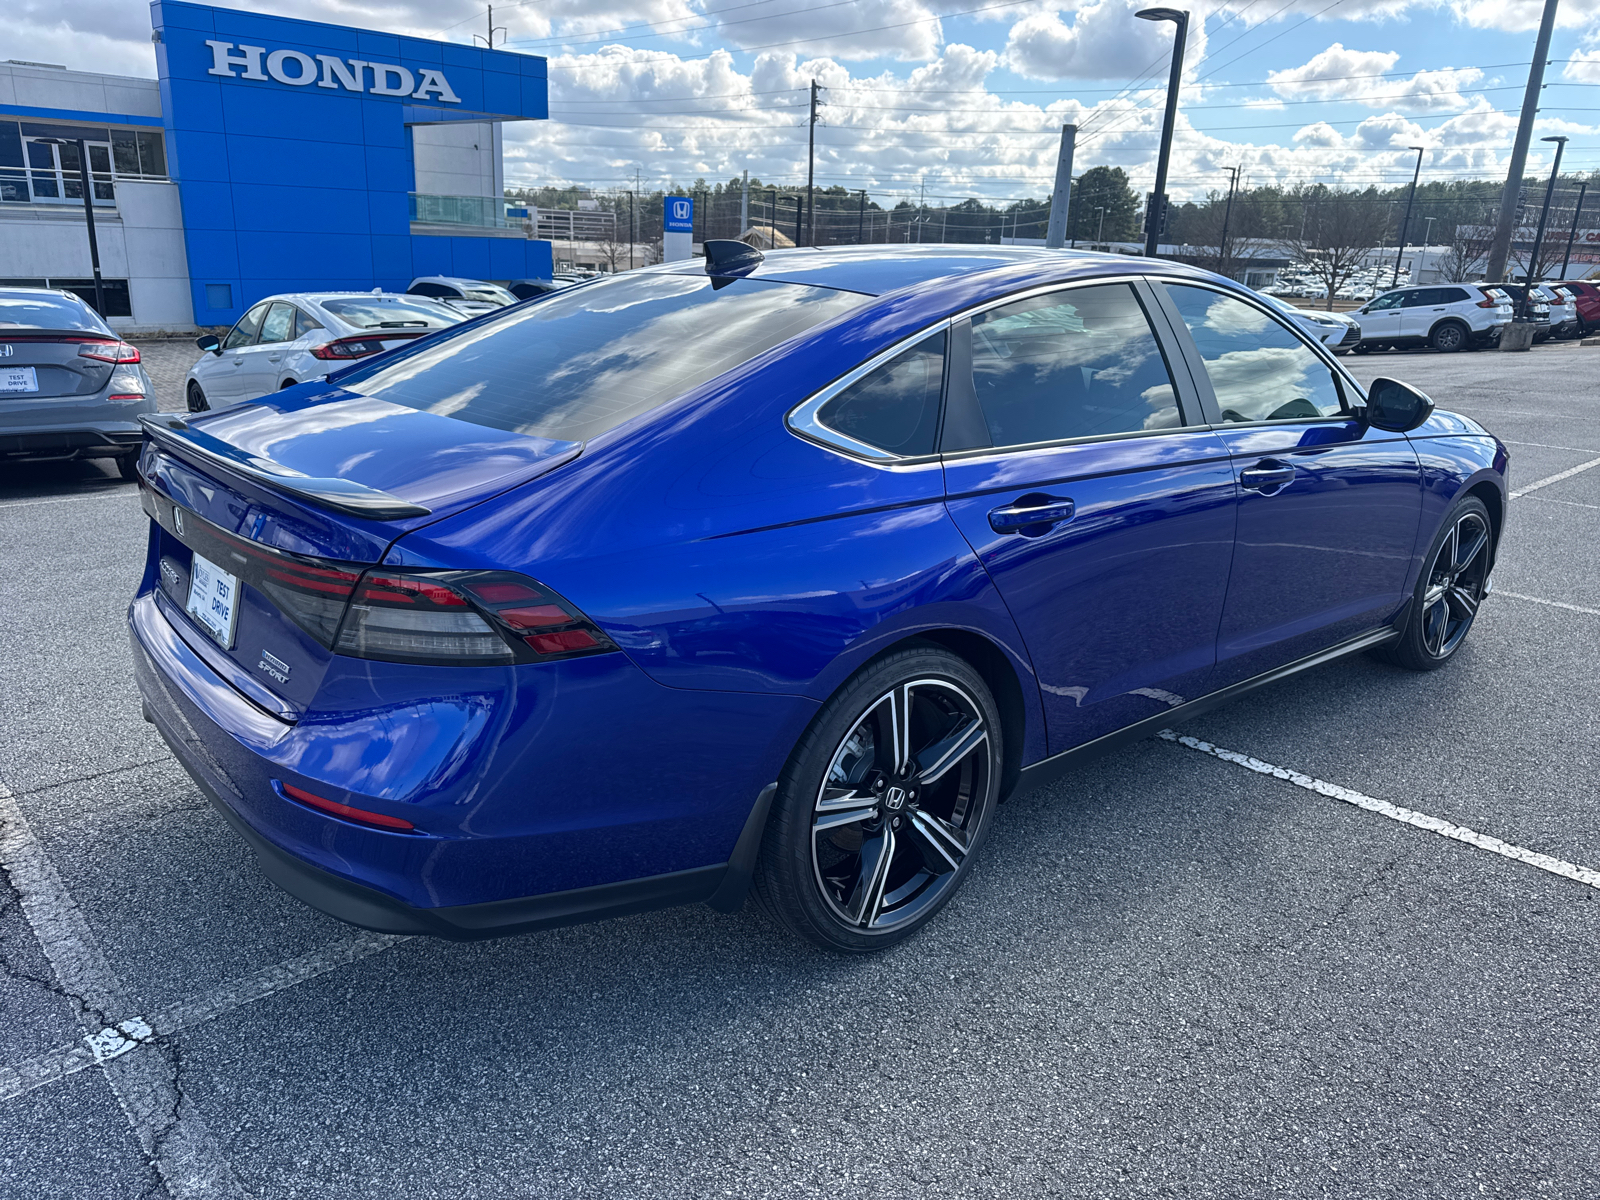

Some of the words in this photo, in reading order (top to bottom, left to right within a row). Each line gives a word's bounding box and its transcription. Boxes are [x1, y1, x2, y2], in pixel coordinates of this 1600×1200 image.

[205, 39, 462, 103] HONDA
[216, 579, 230, 600] TEST
[212, 596, 230, 621] DRIVE
[257, 660, 290, 683] SPORT
